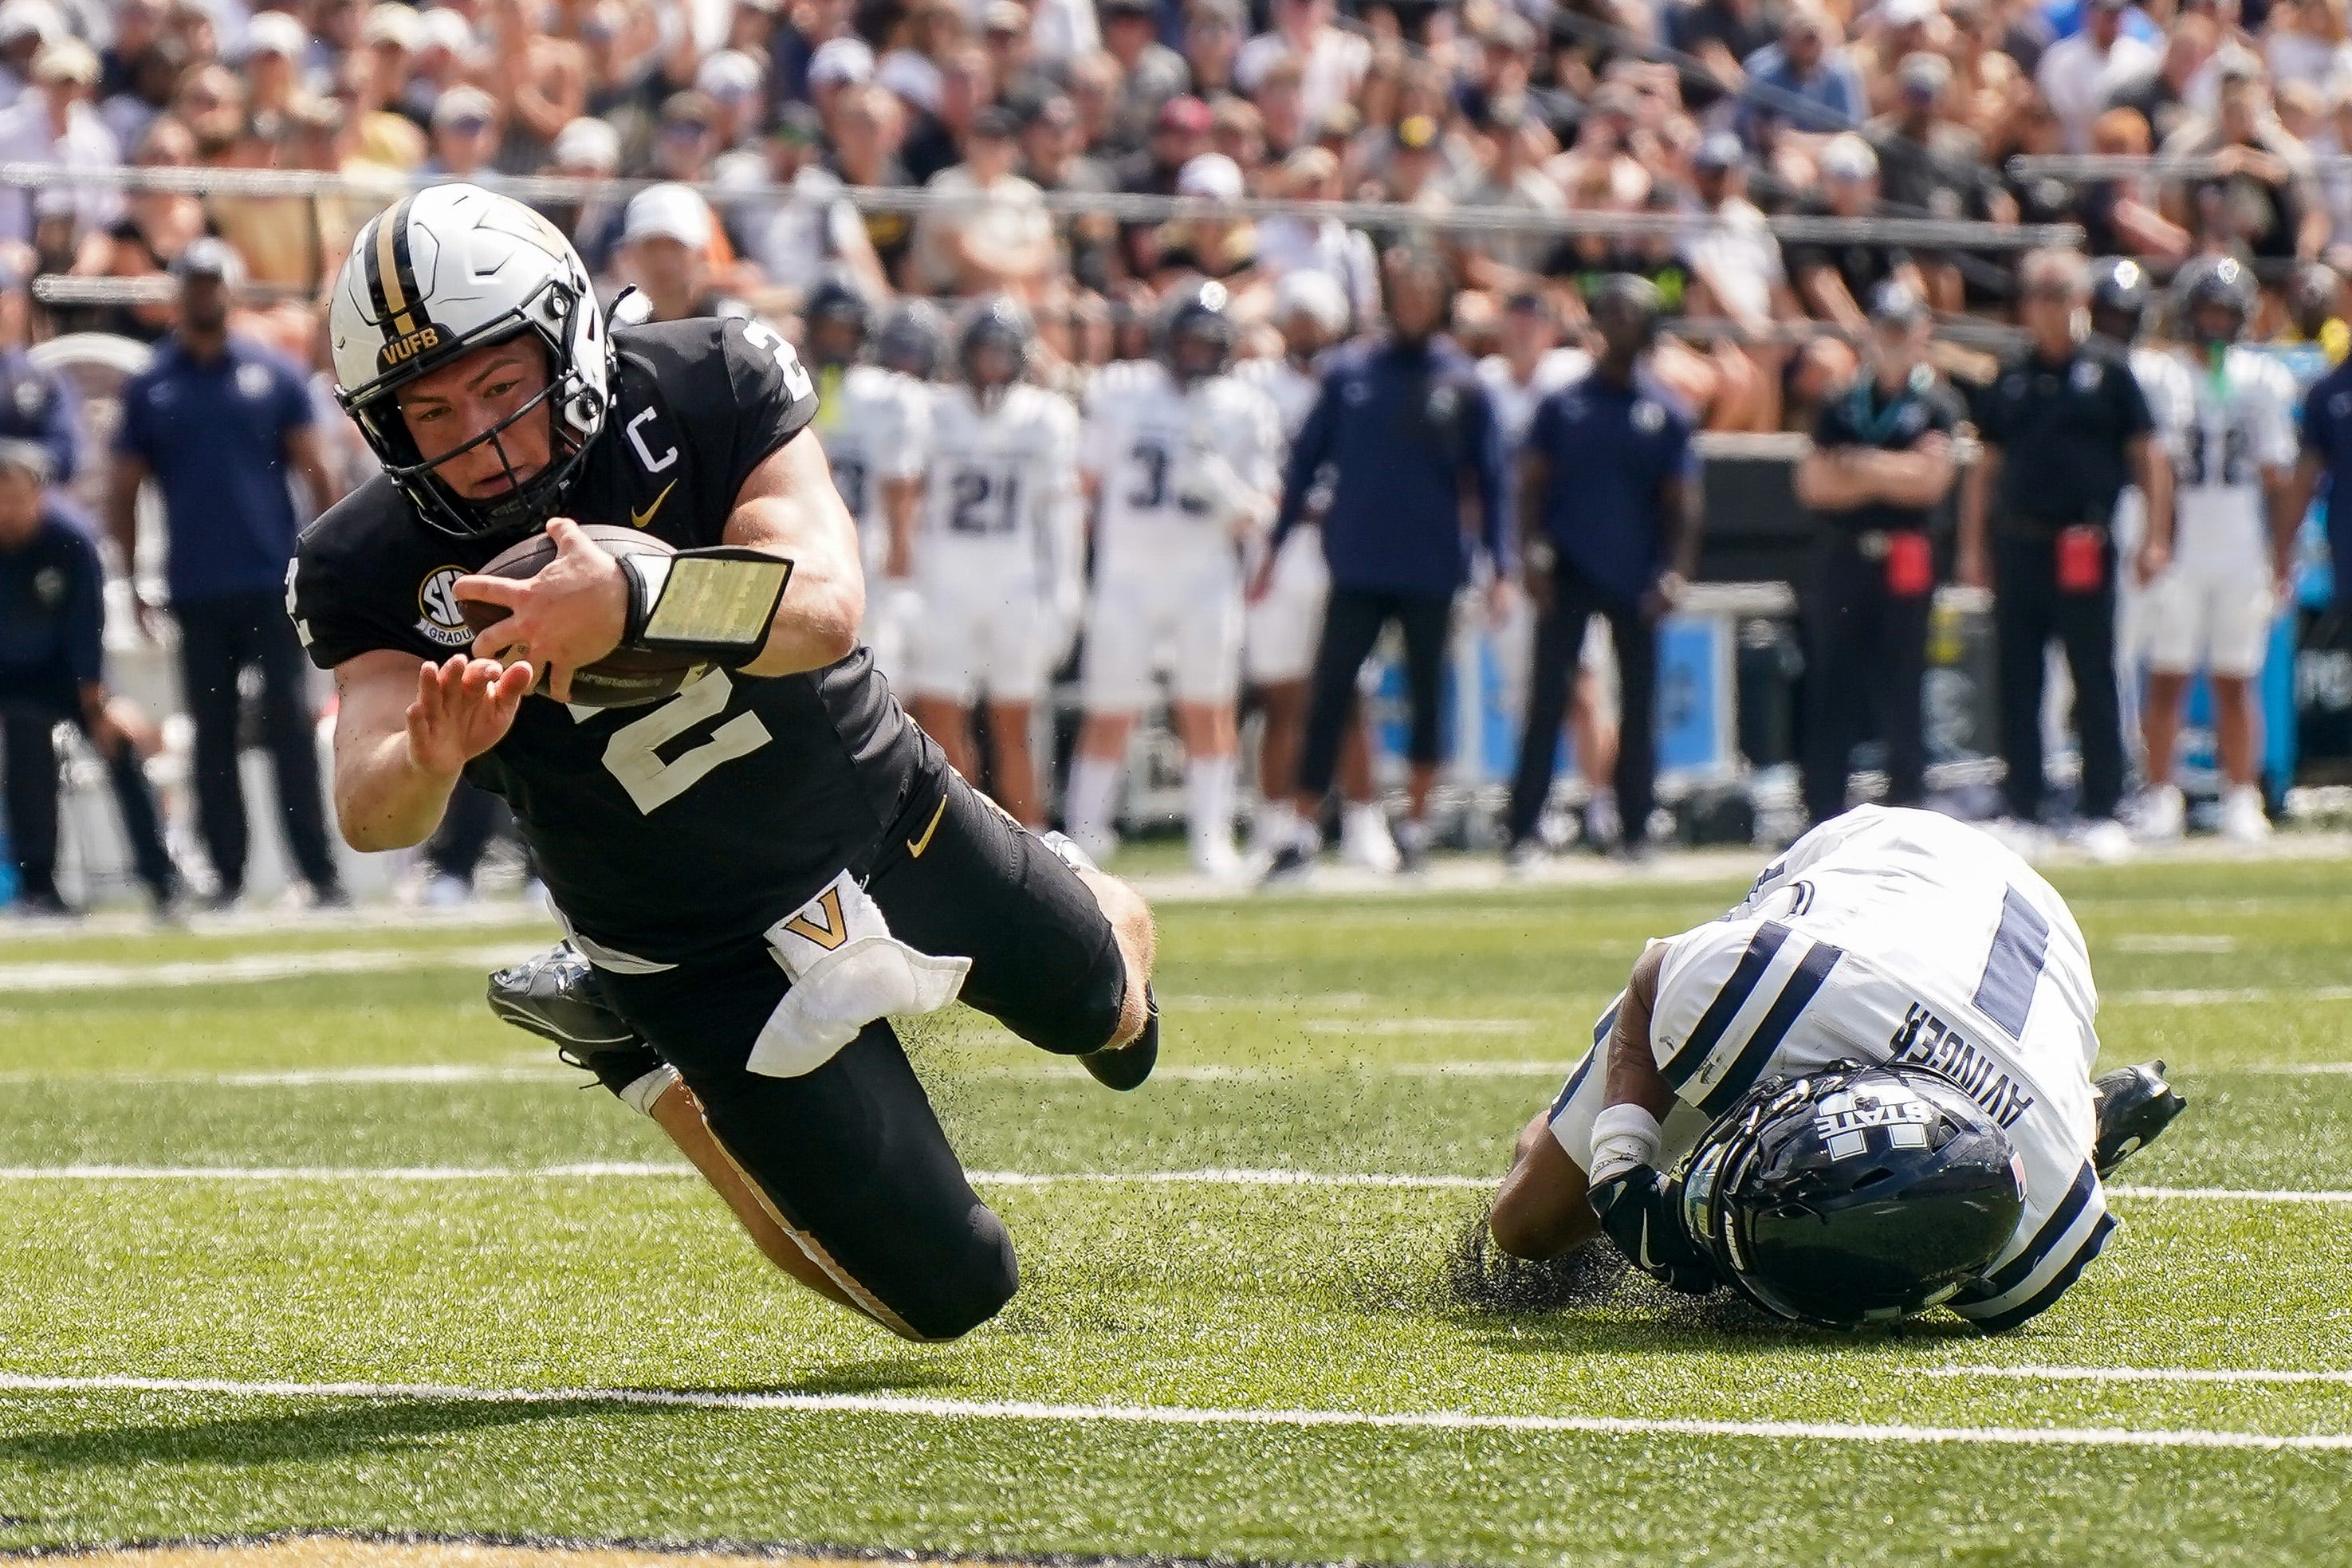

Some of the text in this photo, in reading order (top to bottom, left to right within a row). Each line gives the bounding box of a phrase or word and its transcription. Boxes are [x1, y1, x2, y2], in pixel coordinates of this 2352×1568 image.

[382, 328, 439, 364] VUFB
[626, 406, 678, 473] C
[429, 625, 472, 644] GRADU
[565, 666, 773, 815] 2
[780, 883, 848, 951] V
[1890, 1001, 2035, 1130] AVINGER
[1813, 1100, 1933, 1141] STATE
